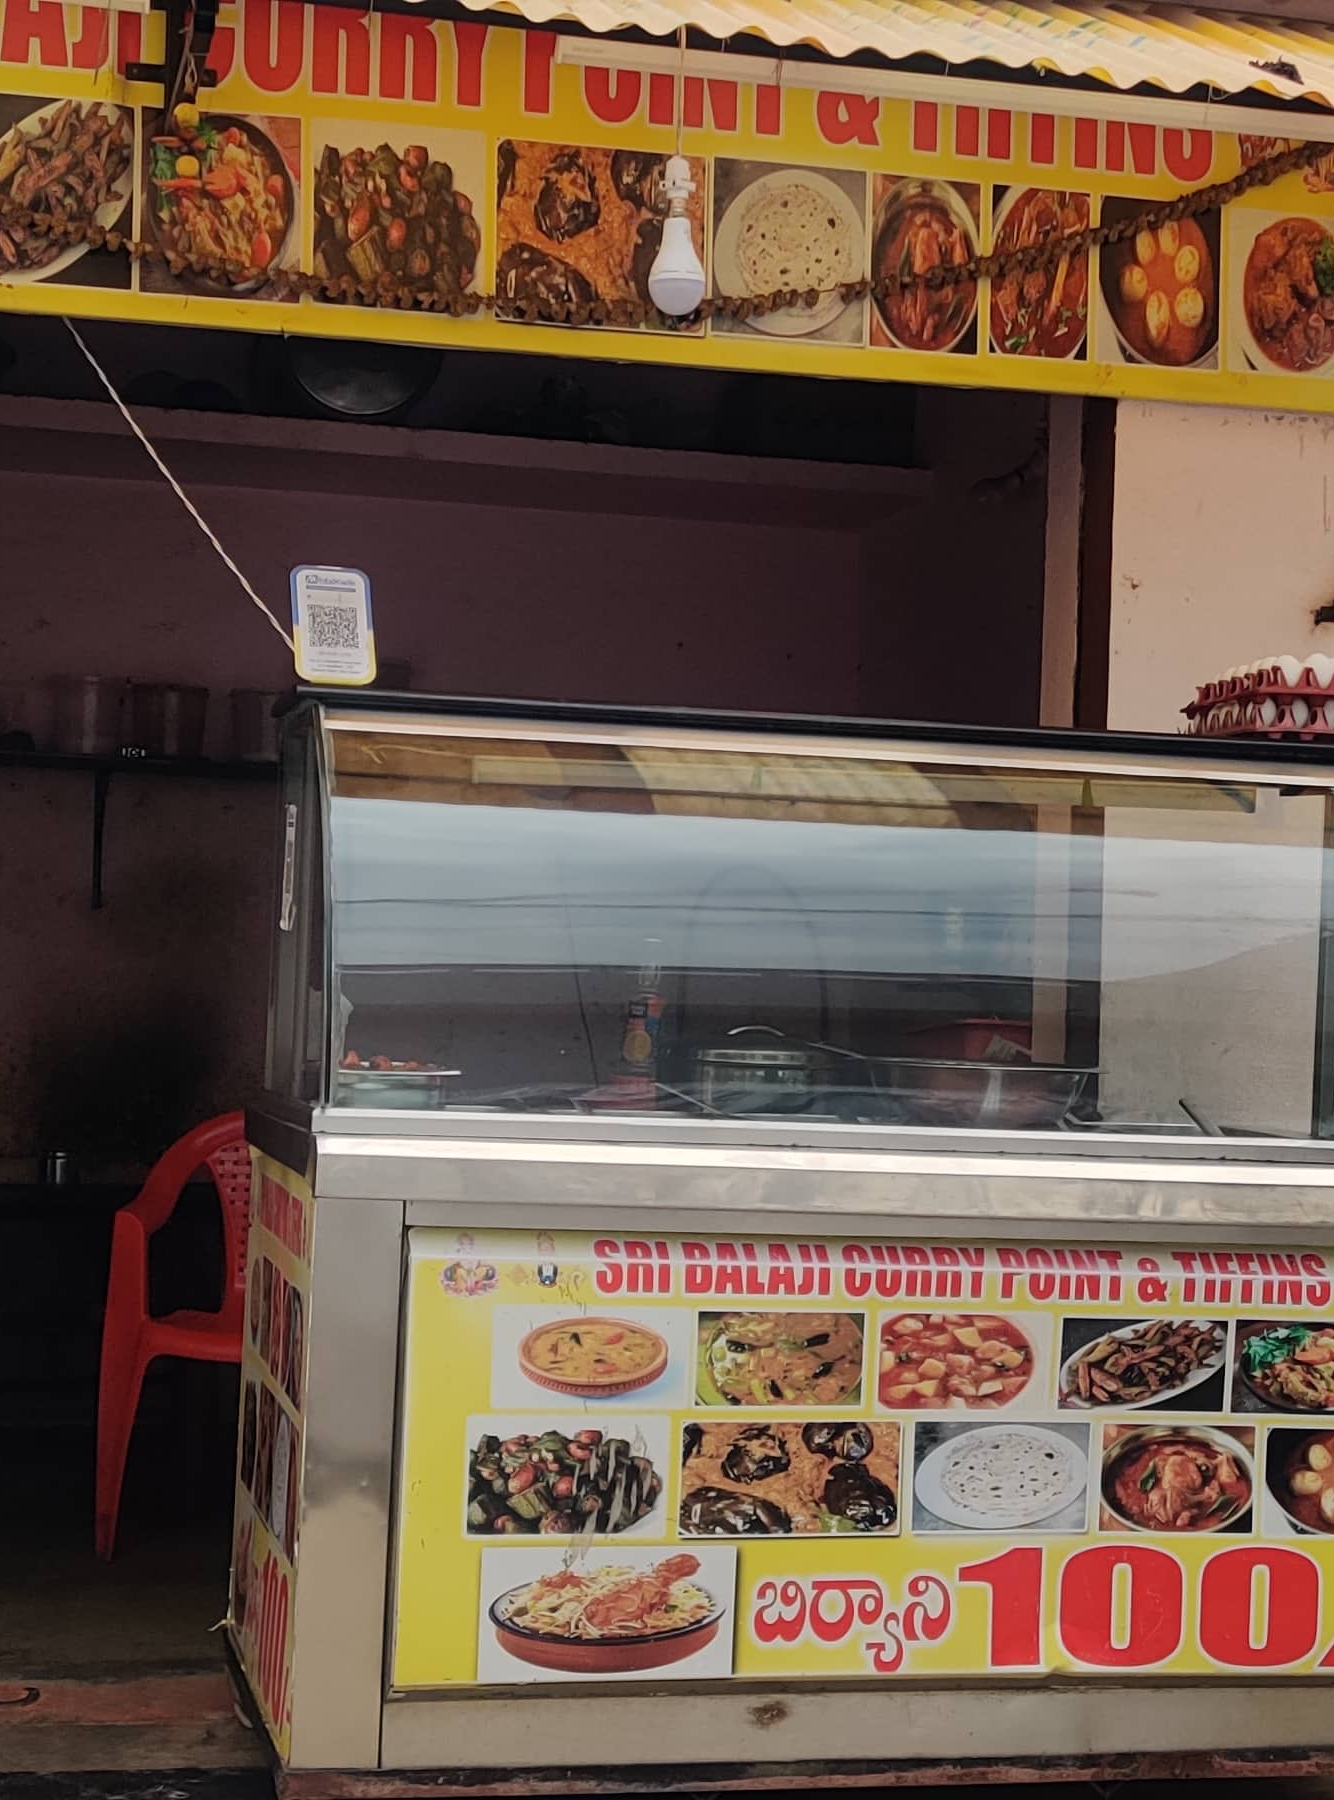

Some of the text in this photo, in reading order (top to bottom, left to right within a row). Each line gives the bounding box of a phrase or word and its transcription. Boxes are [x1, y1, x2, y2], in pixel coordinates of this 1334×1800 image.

[593, 1240, 1331, 1306] SRI BALAJI CURRY POINT & TIFFINS
